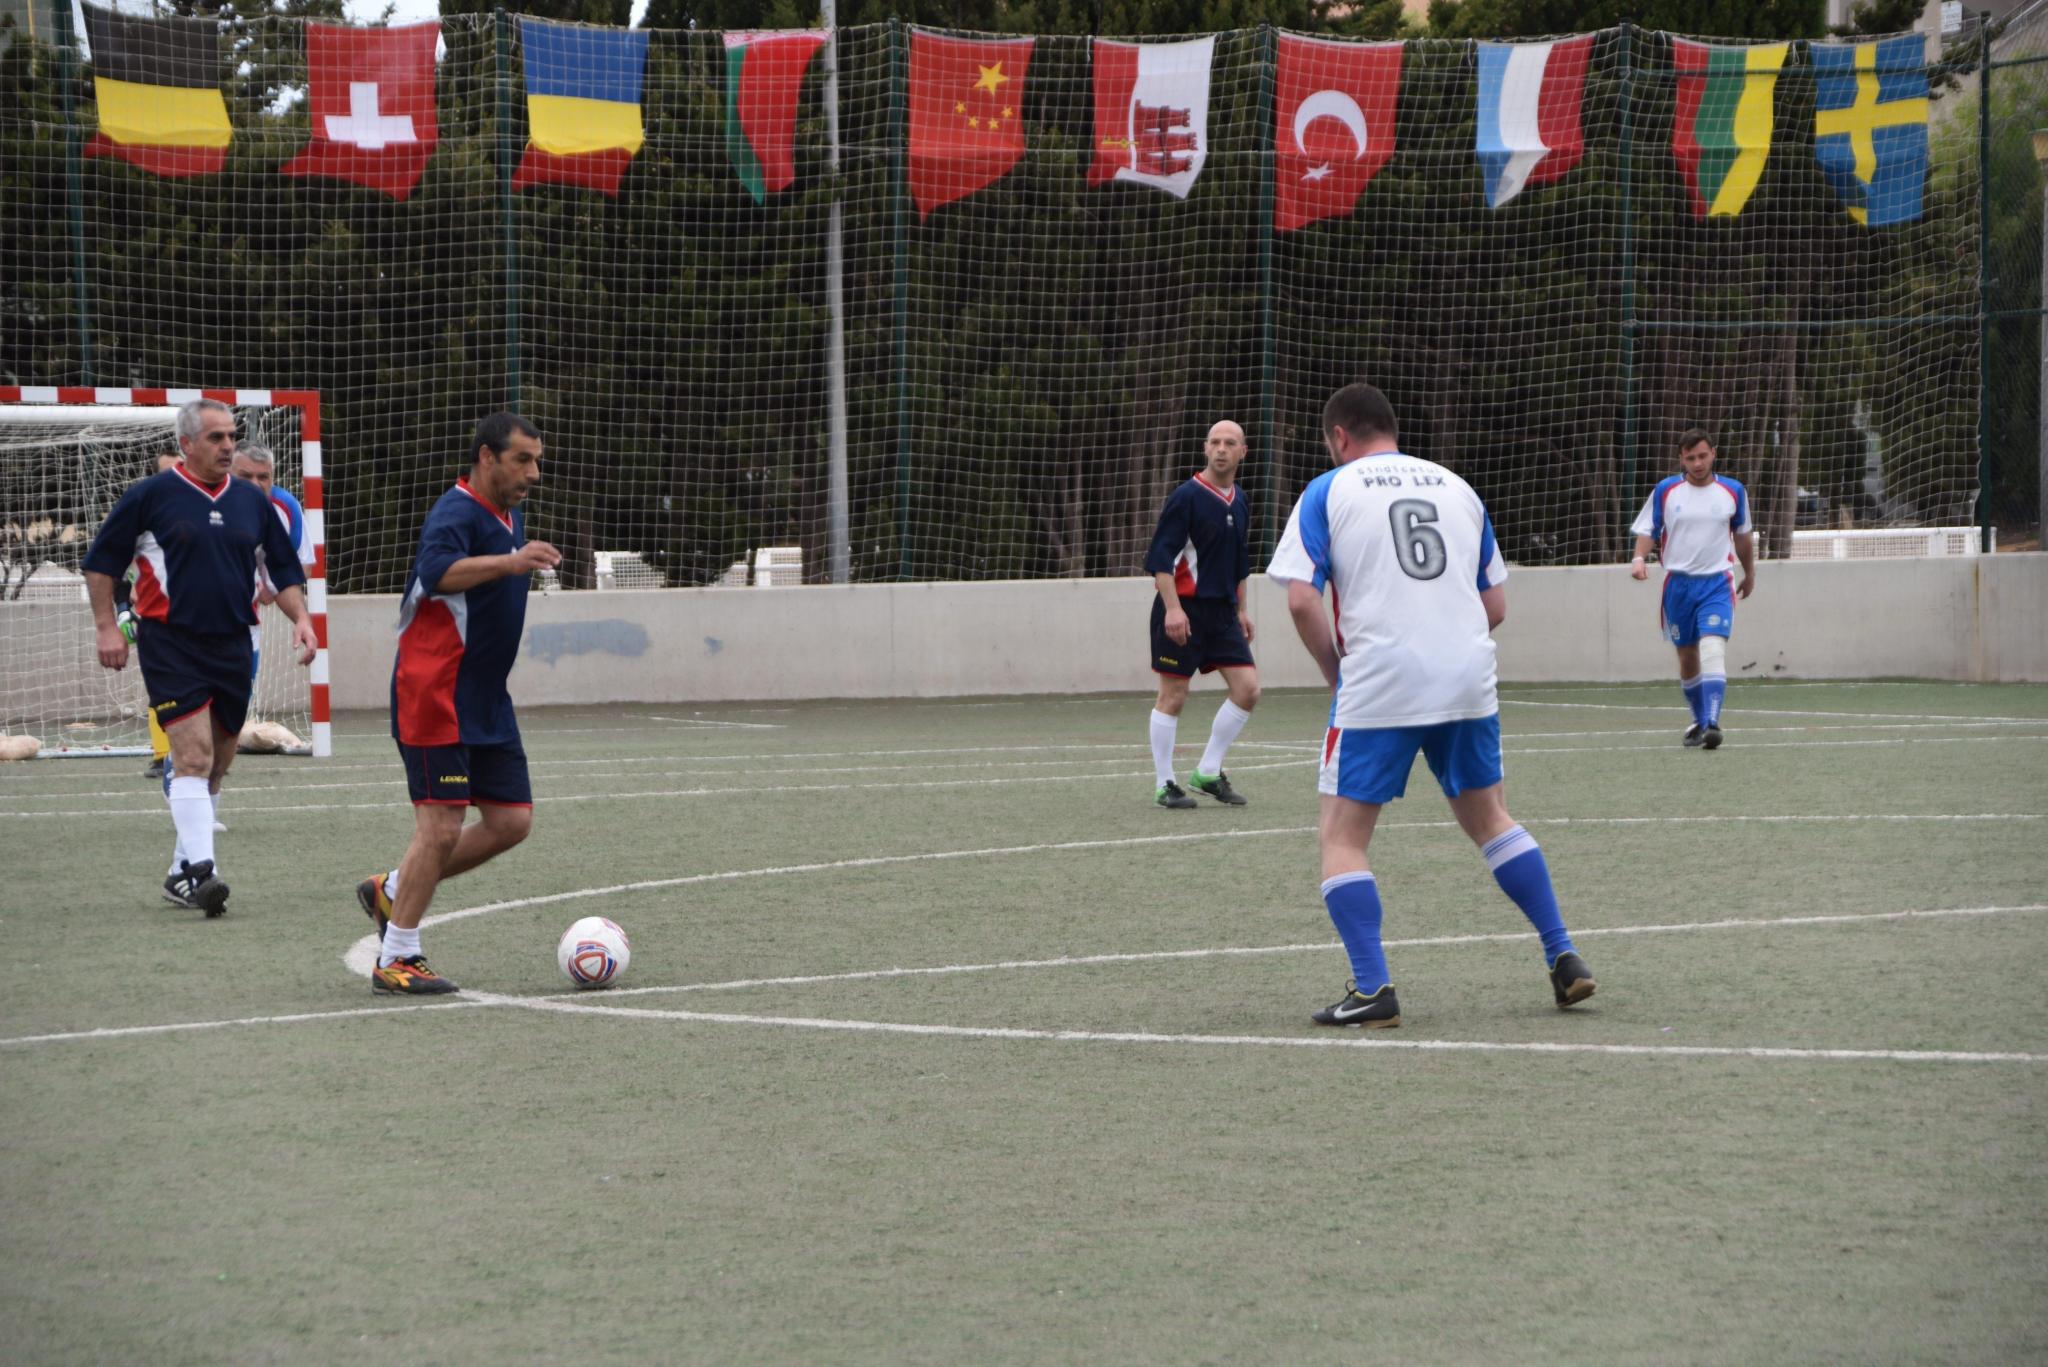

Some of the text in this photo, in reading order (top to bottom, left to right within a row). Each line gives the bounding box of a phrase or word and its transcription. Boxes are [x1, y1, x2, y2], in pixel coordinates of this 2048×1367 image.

[1363, 475, 1446, 488] PRO LEX
[1388, 498, 1447, 581] 6
